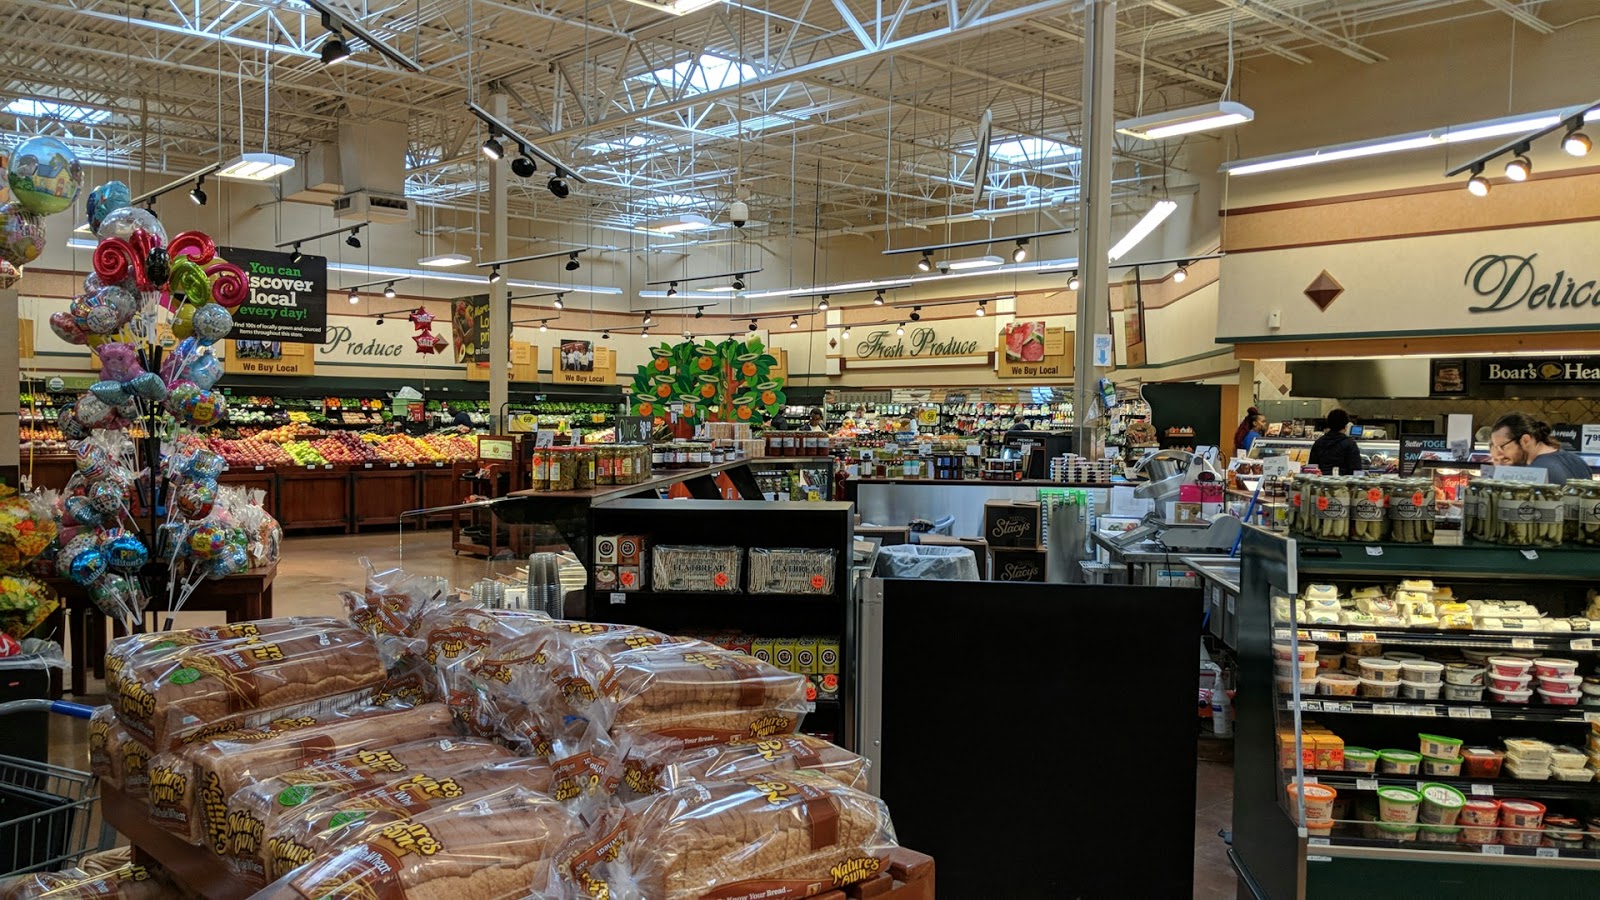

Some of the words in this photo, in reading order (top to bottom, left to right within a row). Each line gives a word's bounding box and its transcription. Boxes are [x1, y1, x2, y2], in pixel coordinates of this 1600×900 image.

[250, 261, 275, 274] You
[278, 266, 302, 277] can
[245, 271, 314, 292] iscover
[249, 288, 298, 307] local
[240, 306, 277, 318] every
[280, 307, 307, 320] day!
[320, 325, 403, 357] Produce
[857, 330, 904, 358] Fresh
[910, 327, 977, 357] Produce
[243, 362, 256, 372] We
[258, 363, 274, 373] Buy
[276, 364, 298, 372] Local
[1011, 366, 1023, 375] We
[1024, 366, 1038, 376] Buy
[1039, 365, 1059, 375] Local
[1489, 362, 1538, 380] Boar's
[576, 375, 588, 383] Buy
[589, 375, 605, 383] Local
[991, 518, 1031, 538] Stacy's
[1000, 562, 1039, 581] Stacy's
[749, 715, 790, 738] Nature's
[756, 725, 777, 738] Own
[697, 735, 714, 743] Bread
[830, 856, 881, 885] Nature's
[841, 867, 867, 887] Own
[749, 890, 766, 899] Your
[766, 886, 787, 897] Bread
